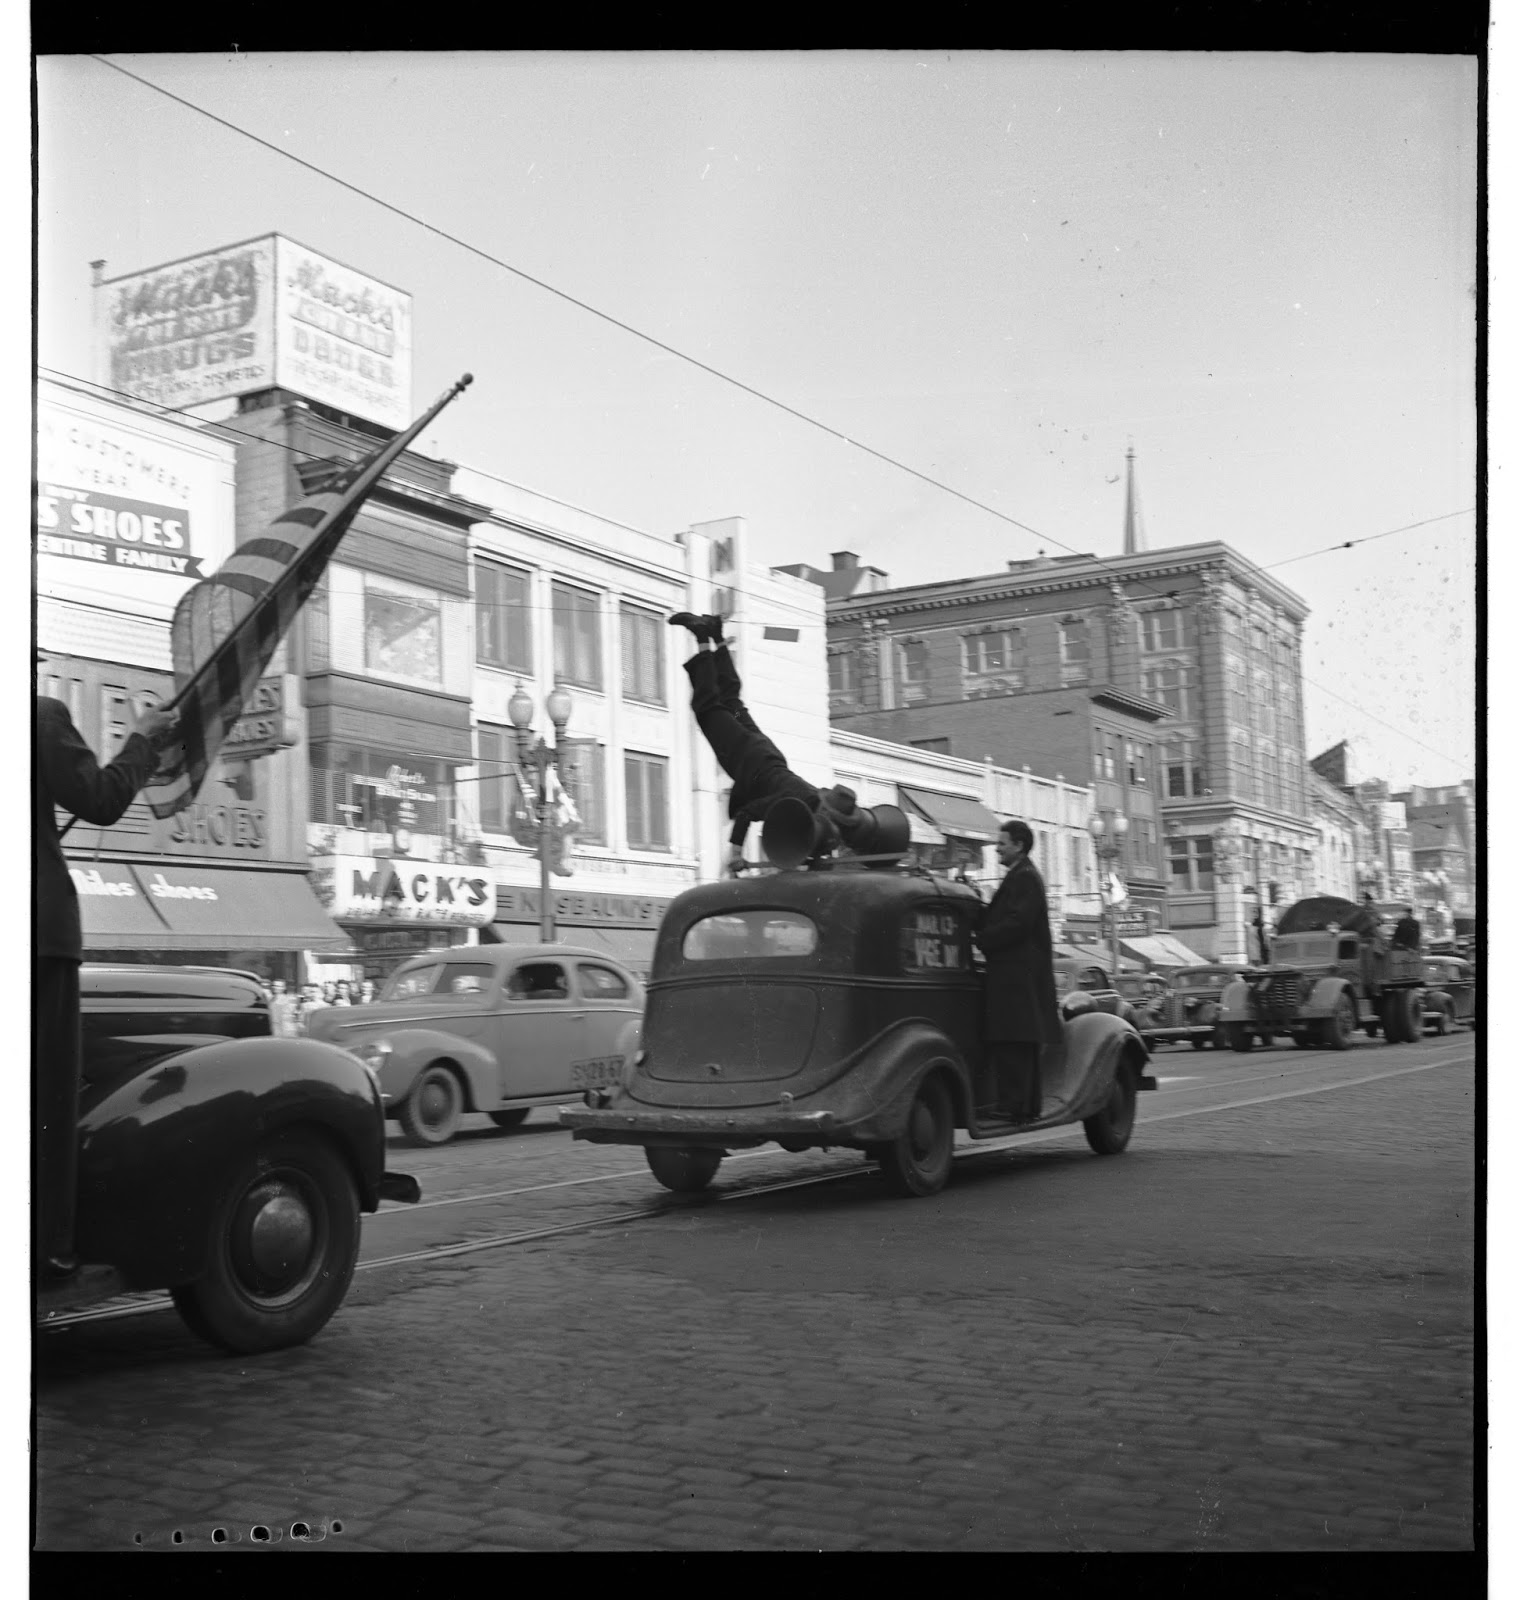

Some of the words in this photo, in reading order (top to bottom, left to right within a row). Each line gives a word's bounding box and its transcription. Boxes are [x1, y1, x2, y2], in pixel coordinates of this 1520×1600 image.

[69, 427, 190, 501] CUSTOMERS
[70, 503, 184, 550] SHOES
[115, 547, 189, 573] FAMILY
[170, 803, 266, 849] SHOES
[150, 873, 219, 901] shoes
[353, 869, 488, 907] MACK'S
